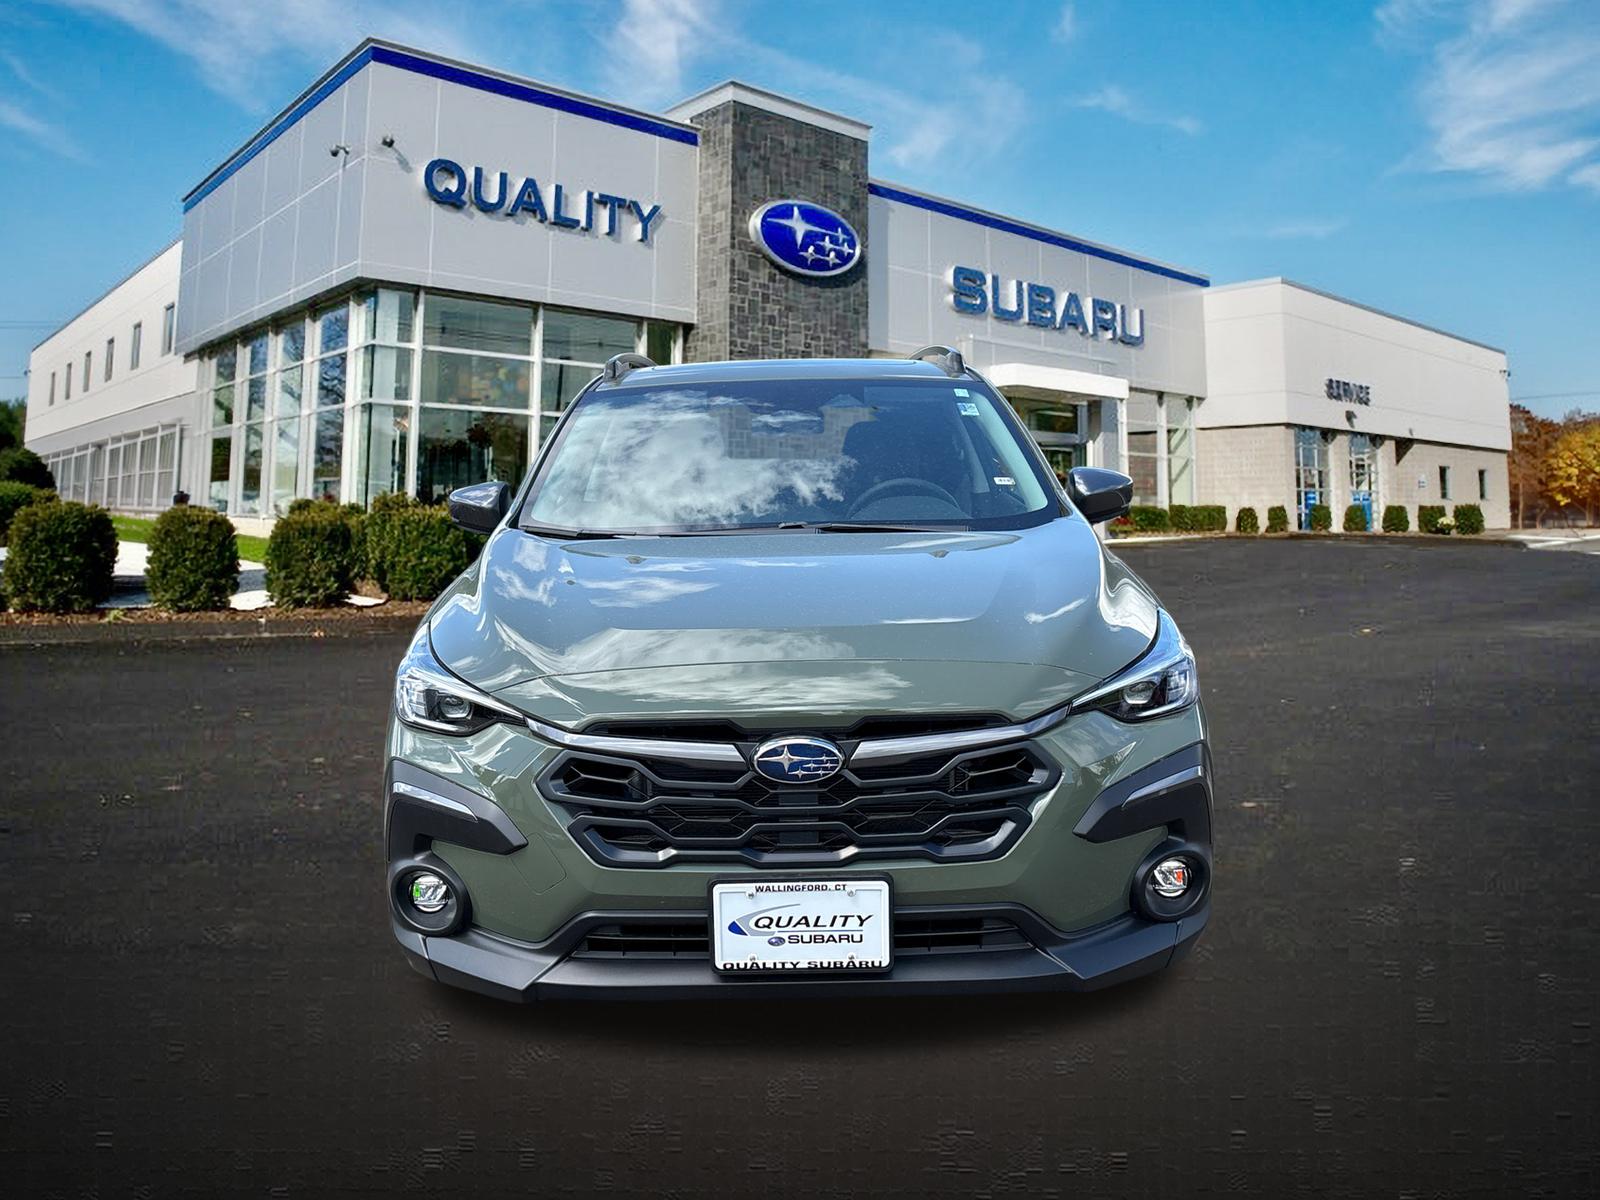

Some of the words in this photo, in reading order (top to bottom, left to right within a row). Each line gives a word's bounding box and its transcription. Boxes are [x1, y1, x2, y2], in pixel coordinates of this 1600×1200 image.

[424, 159, 661, 243] QUALITY
[952, 265, 1145, 347] SUBARU
[754, 915, 873, 929] QUALITY
[788, 934, 863, 944] SUBARU
[723, 962, 800, 970] QUALITY
[808, 960, 882, 968] SUBARU
